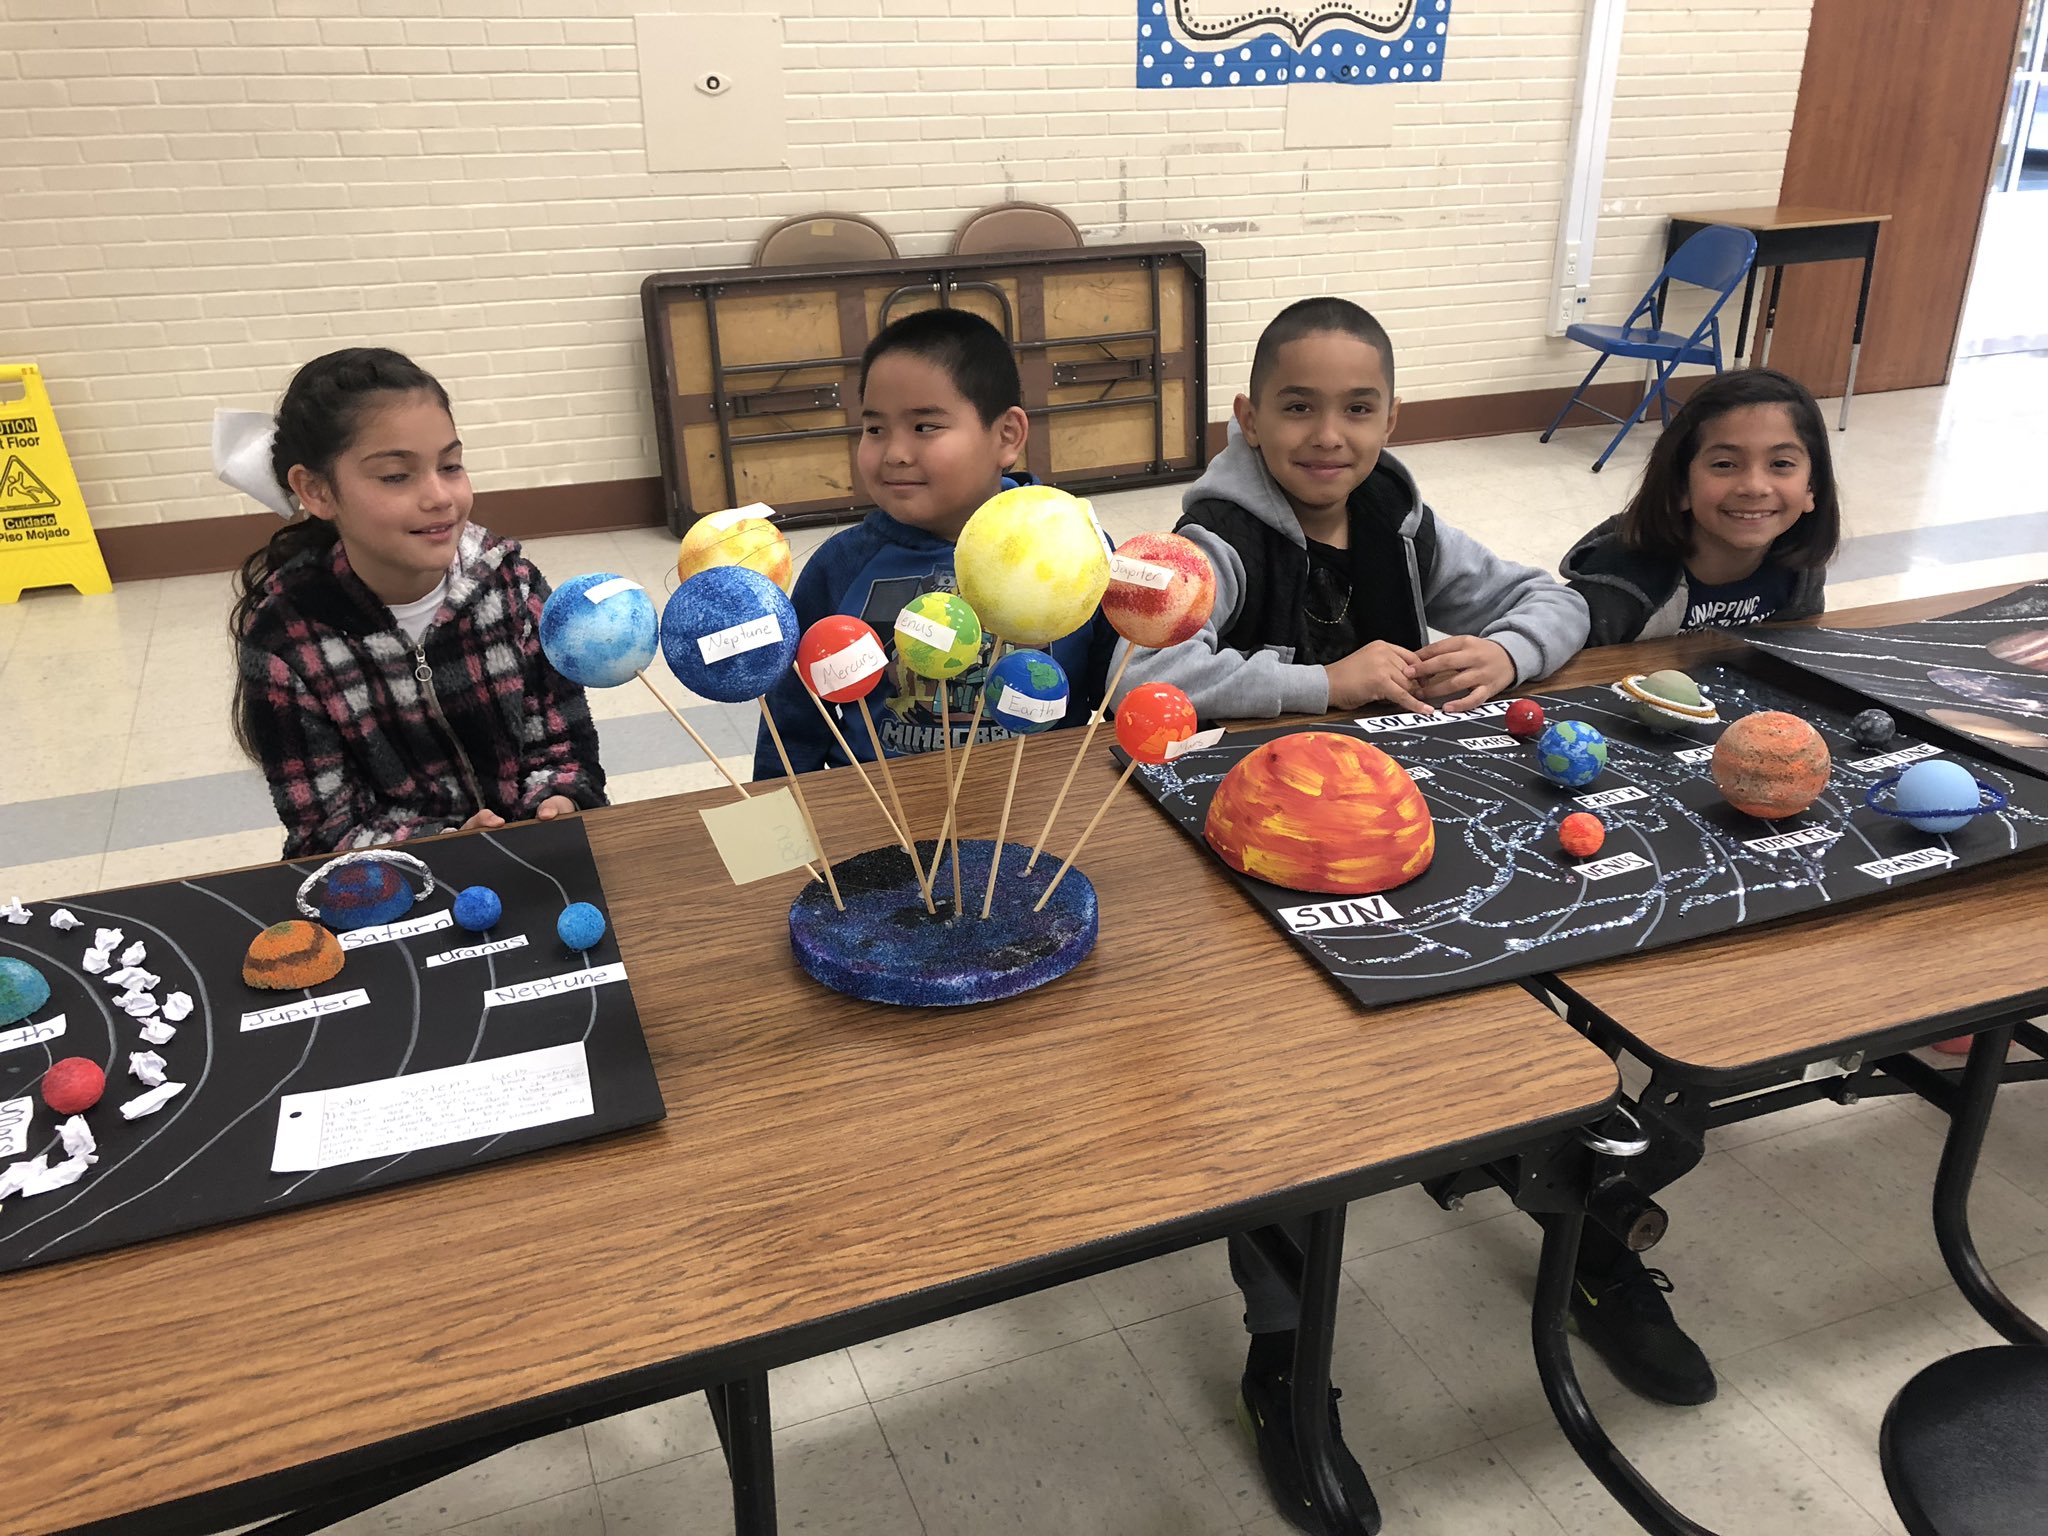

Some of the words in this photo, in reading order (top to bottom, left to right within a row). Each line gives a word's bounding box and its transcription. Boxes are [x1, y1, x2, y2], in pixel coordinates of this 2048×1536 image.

[7, 436, 40, 449] Floor
[5, 516, 56, 529] Cuidado
[26, 527, 70, 541] Mojado
[1112, 559, 1162, 581] Jupiter
[708, 624, 772, 650] Neptune
[901, 616, 933, 637] enus
[823, 652, 878, 685] Mercury
[1008, 696, 1055, 718] Earth
[881, 722, 1019, 752] MINECRA
[1463, 735, 1515, 749] MARS
[1683, 746, 1714, 760] SAT
[1852, 744, 1935, 771] NEPTUNE
[1578, 787, 1641, 808] EARTH
[1753, 827, 1833, 851] JUPITER
[1581, 855, 1645, 877] VENUS
[1866, 850, 1951, 876] URANUS
[1295, 898, 1384, 928] SUN
[344, 915, 451, 948] Saturn
[438, 936, 526, 963] Uranus
[496, 970, 608, 1001] Neptune
[245, 994, 361, 1027] Jupiter
